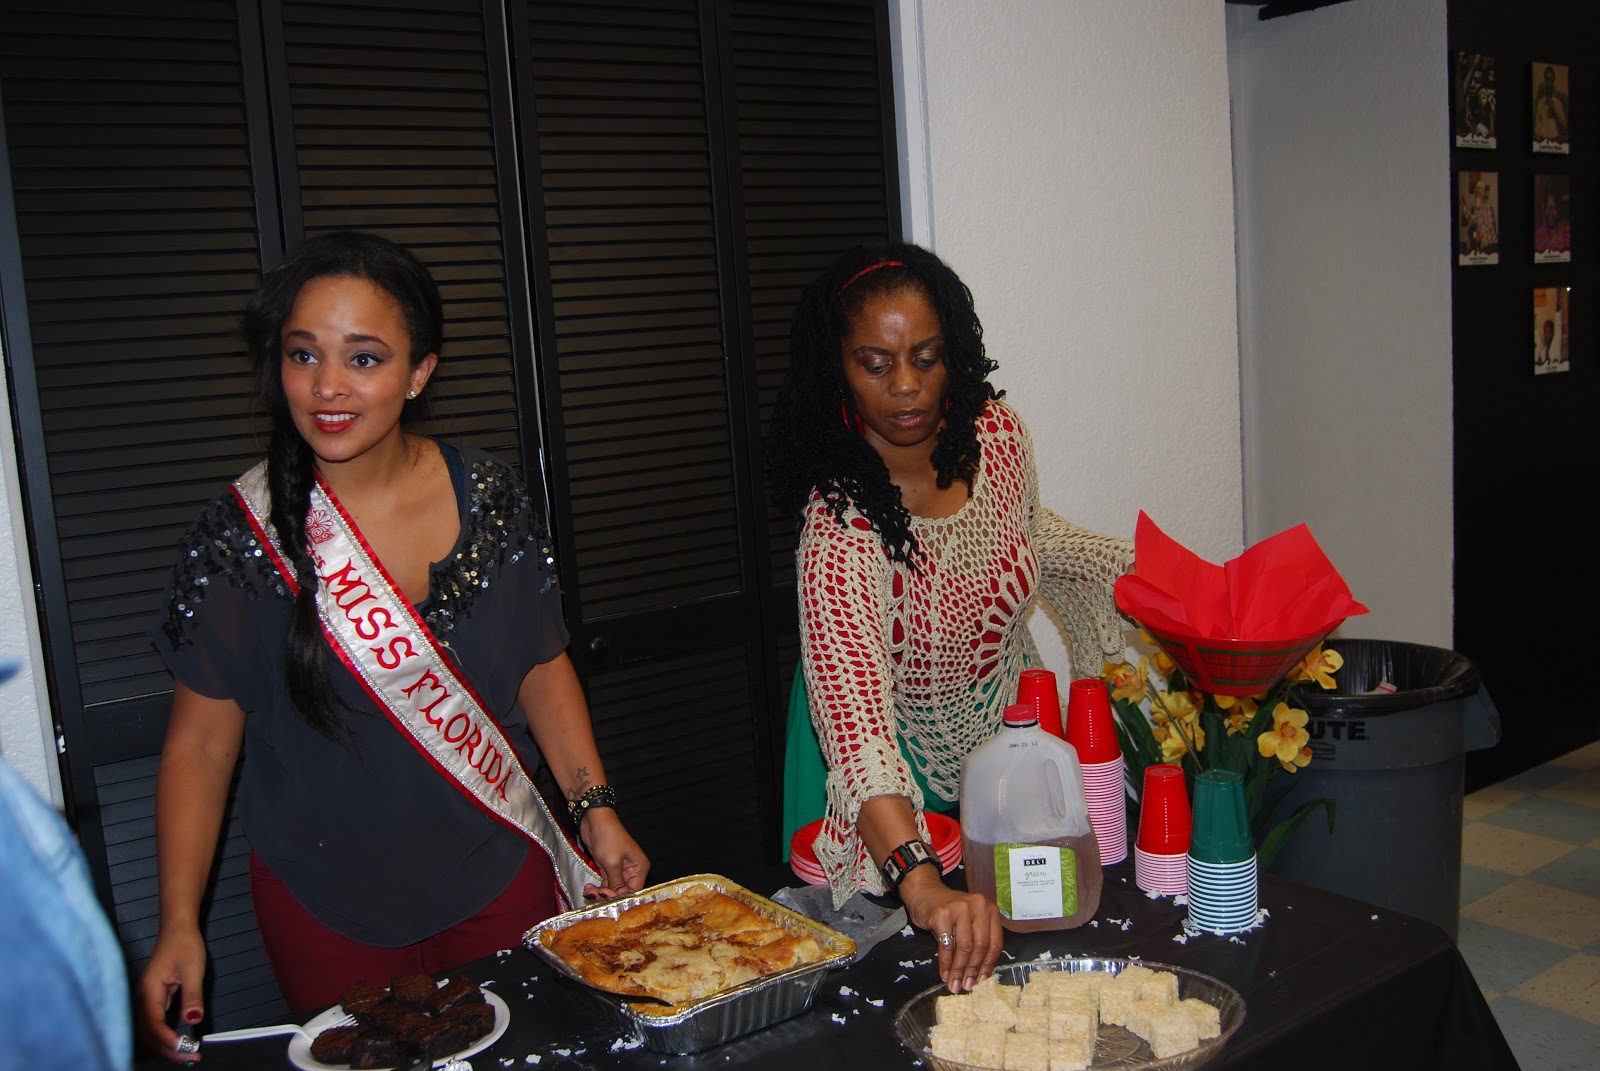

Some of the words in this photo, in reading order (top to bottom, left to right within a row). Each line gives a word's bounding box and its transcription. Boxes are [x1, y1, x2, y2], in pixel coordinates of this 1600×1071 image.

[319, 557, 420, 670] MISS
[401, 668, 514, 803] FLORIDA
[1308, 720, 1366, 740] UTE
[1024, 871, 1047, 881] green
